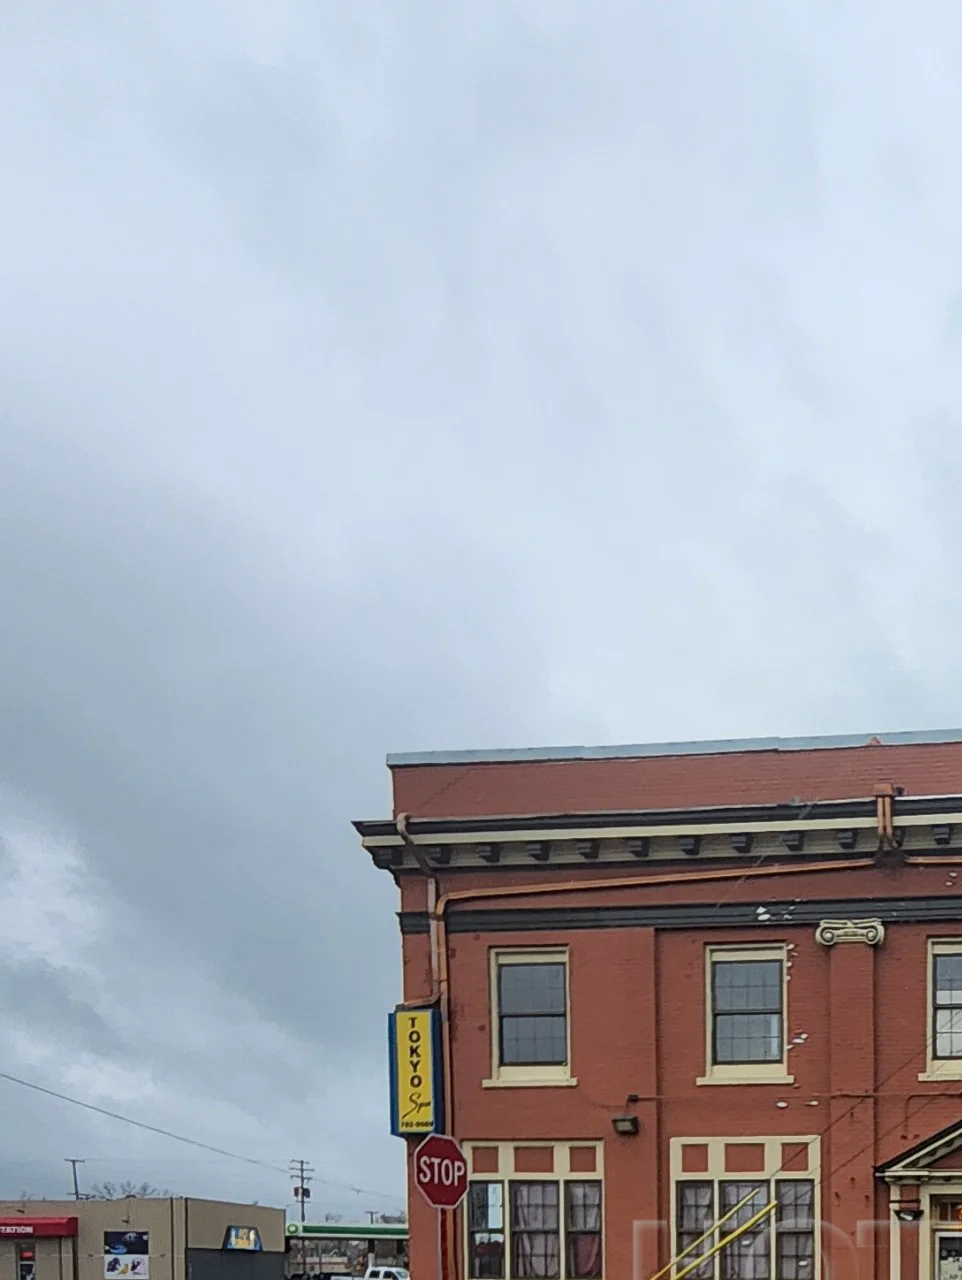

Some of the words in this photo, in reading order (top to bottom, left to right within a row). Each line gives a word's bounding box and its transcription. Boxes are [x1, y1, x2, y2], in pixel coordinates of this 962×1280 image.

[408, 1016, 423, 1089] TOKYO
[401, 1091, 432, 1119] Spa
[419, 1155, 466, 1187] STOP
